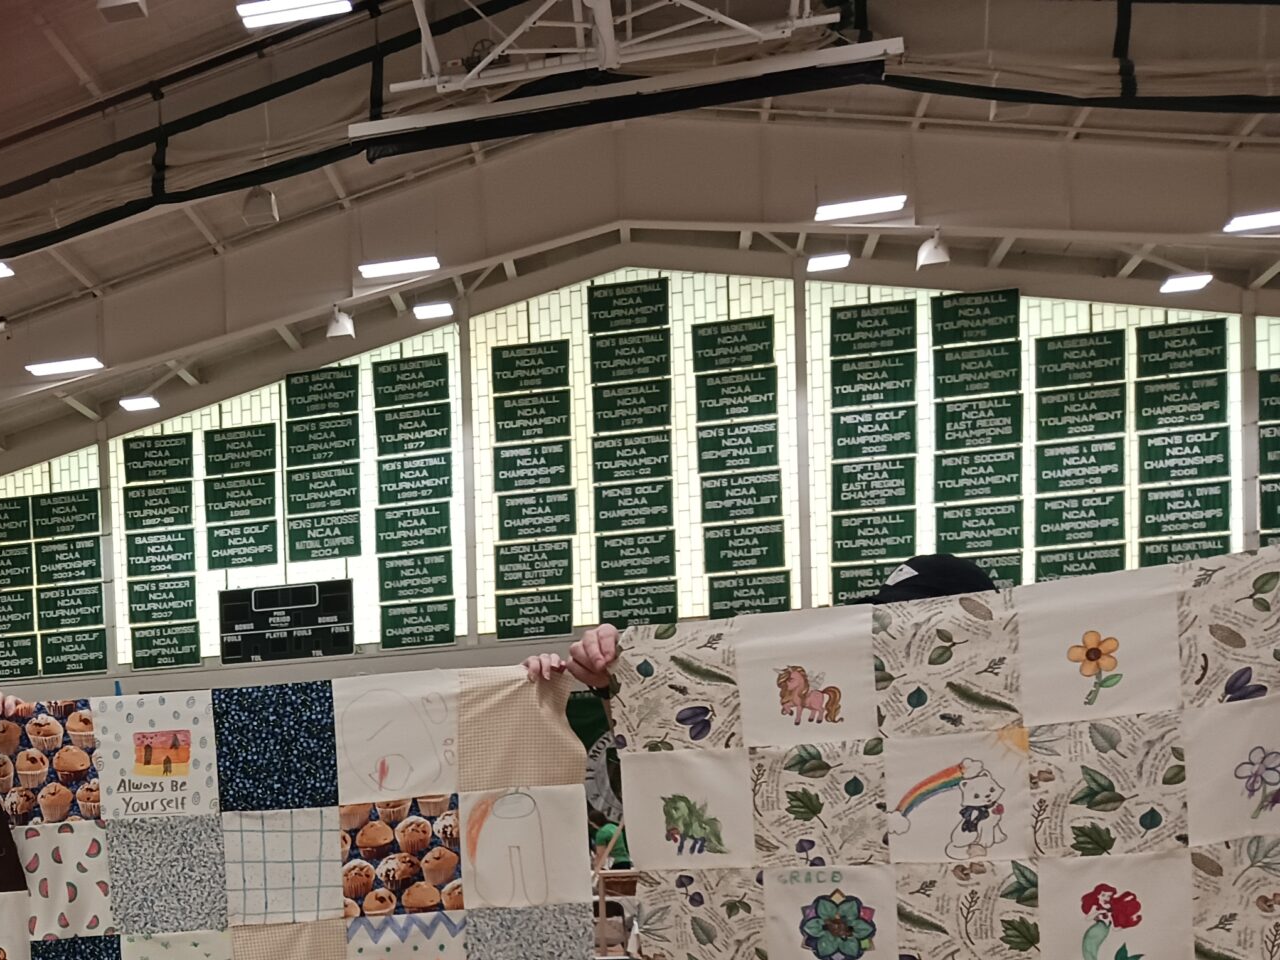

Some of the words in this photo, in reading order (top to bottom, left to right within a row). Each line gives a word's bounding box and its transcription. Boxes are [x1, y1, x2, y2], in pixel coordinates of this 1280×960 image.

[947, 399, 1011, 412] SOFTBALL
[385, 408, 441, 421] BASEBALL
[876, 410, 907, 421] GOLF
[962, 409, 995, 419] NCAA
[399, 421, 427, 430] NCAA
[727, 423, 776, 435] LACROSSE
[858, 423, 889, 433] NCAA
[946, 421, 972, 431] EAST
[976, 418, 1011, 428] REGION
[379, 428, 448, 442] TOURNAMENT
[945, 426, 1012, 439] CHAMPIONS
[1186, 432, 1219, 443] GOLF
[722, 437, 752, 446] NCAA
[837, 432, 911, 446] CHAMPIONSHIPS
[701, 445, 774, 459] SEMIFINALIST
[1166, 445, 1200, 456] NCAA
[974, 452, 1015, 463] SOCCER
[1144, 454, 1224, 469] CHAMPIONSHIPS
[843, 461, 904, 473] SOFTBALL
[961, 465, 994, 475] NCAA
[857, 471, 889, 481] NCAA
[937, 474, 1019, 488] TOURNAMENT
[842, 482, 866, 491] EAST
[871, 479, 904, 489] REGION
[841, 488, 905, 500] CHAMPIONS
[385, 507, 440, 519] SOFTBALL
[314, 514, 358, 526] LACROSSE
[398, 519, 426, 528] NCAA
[243, 525, 269, 534] GOLF
[307, 527, 341, 538] NCAA
[378, 526, 448, 540] TOURNAMENT
[135, 534, 185, 544] BASEBALL
[228, 537, 255, 545] NCAA
[147, 545, 173, 553] NCAA
[212, 545, 273, 557] CHAMPIONSHIPS
[500, 545, 530, 555] ALISON
[533, 542, 568, 552] LESHER
[129, 553, 193, 564] TOURNAMENT
[519, 553, 547, 561] NCAA
[525, 568, 563, 579] BUTTERFLY
[159, 581, 190, 589] SOCCER
[131, 600, 193, 611] TOURNAMENT
[505, 594, 562, 606] BASEBALL
[519, 606, 548, 615] NCAA
[498, 614, 569, 626] TOURNAMENT
[75, 633, 99, 642] GOLF
[46, 652, 103, 663] CHAMPIONSHIPS
[117, 779, 164, 792] Always
[170, 780, 187, 791] Be
[122, 797, 186, 813] Yourself
